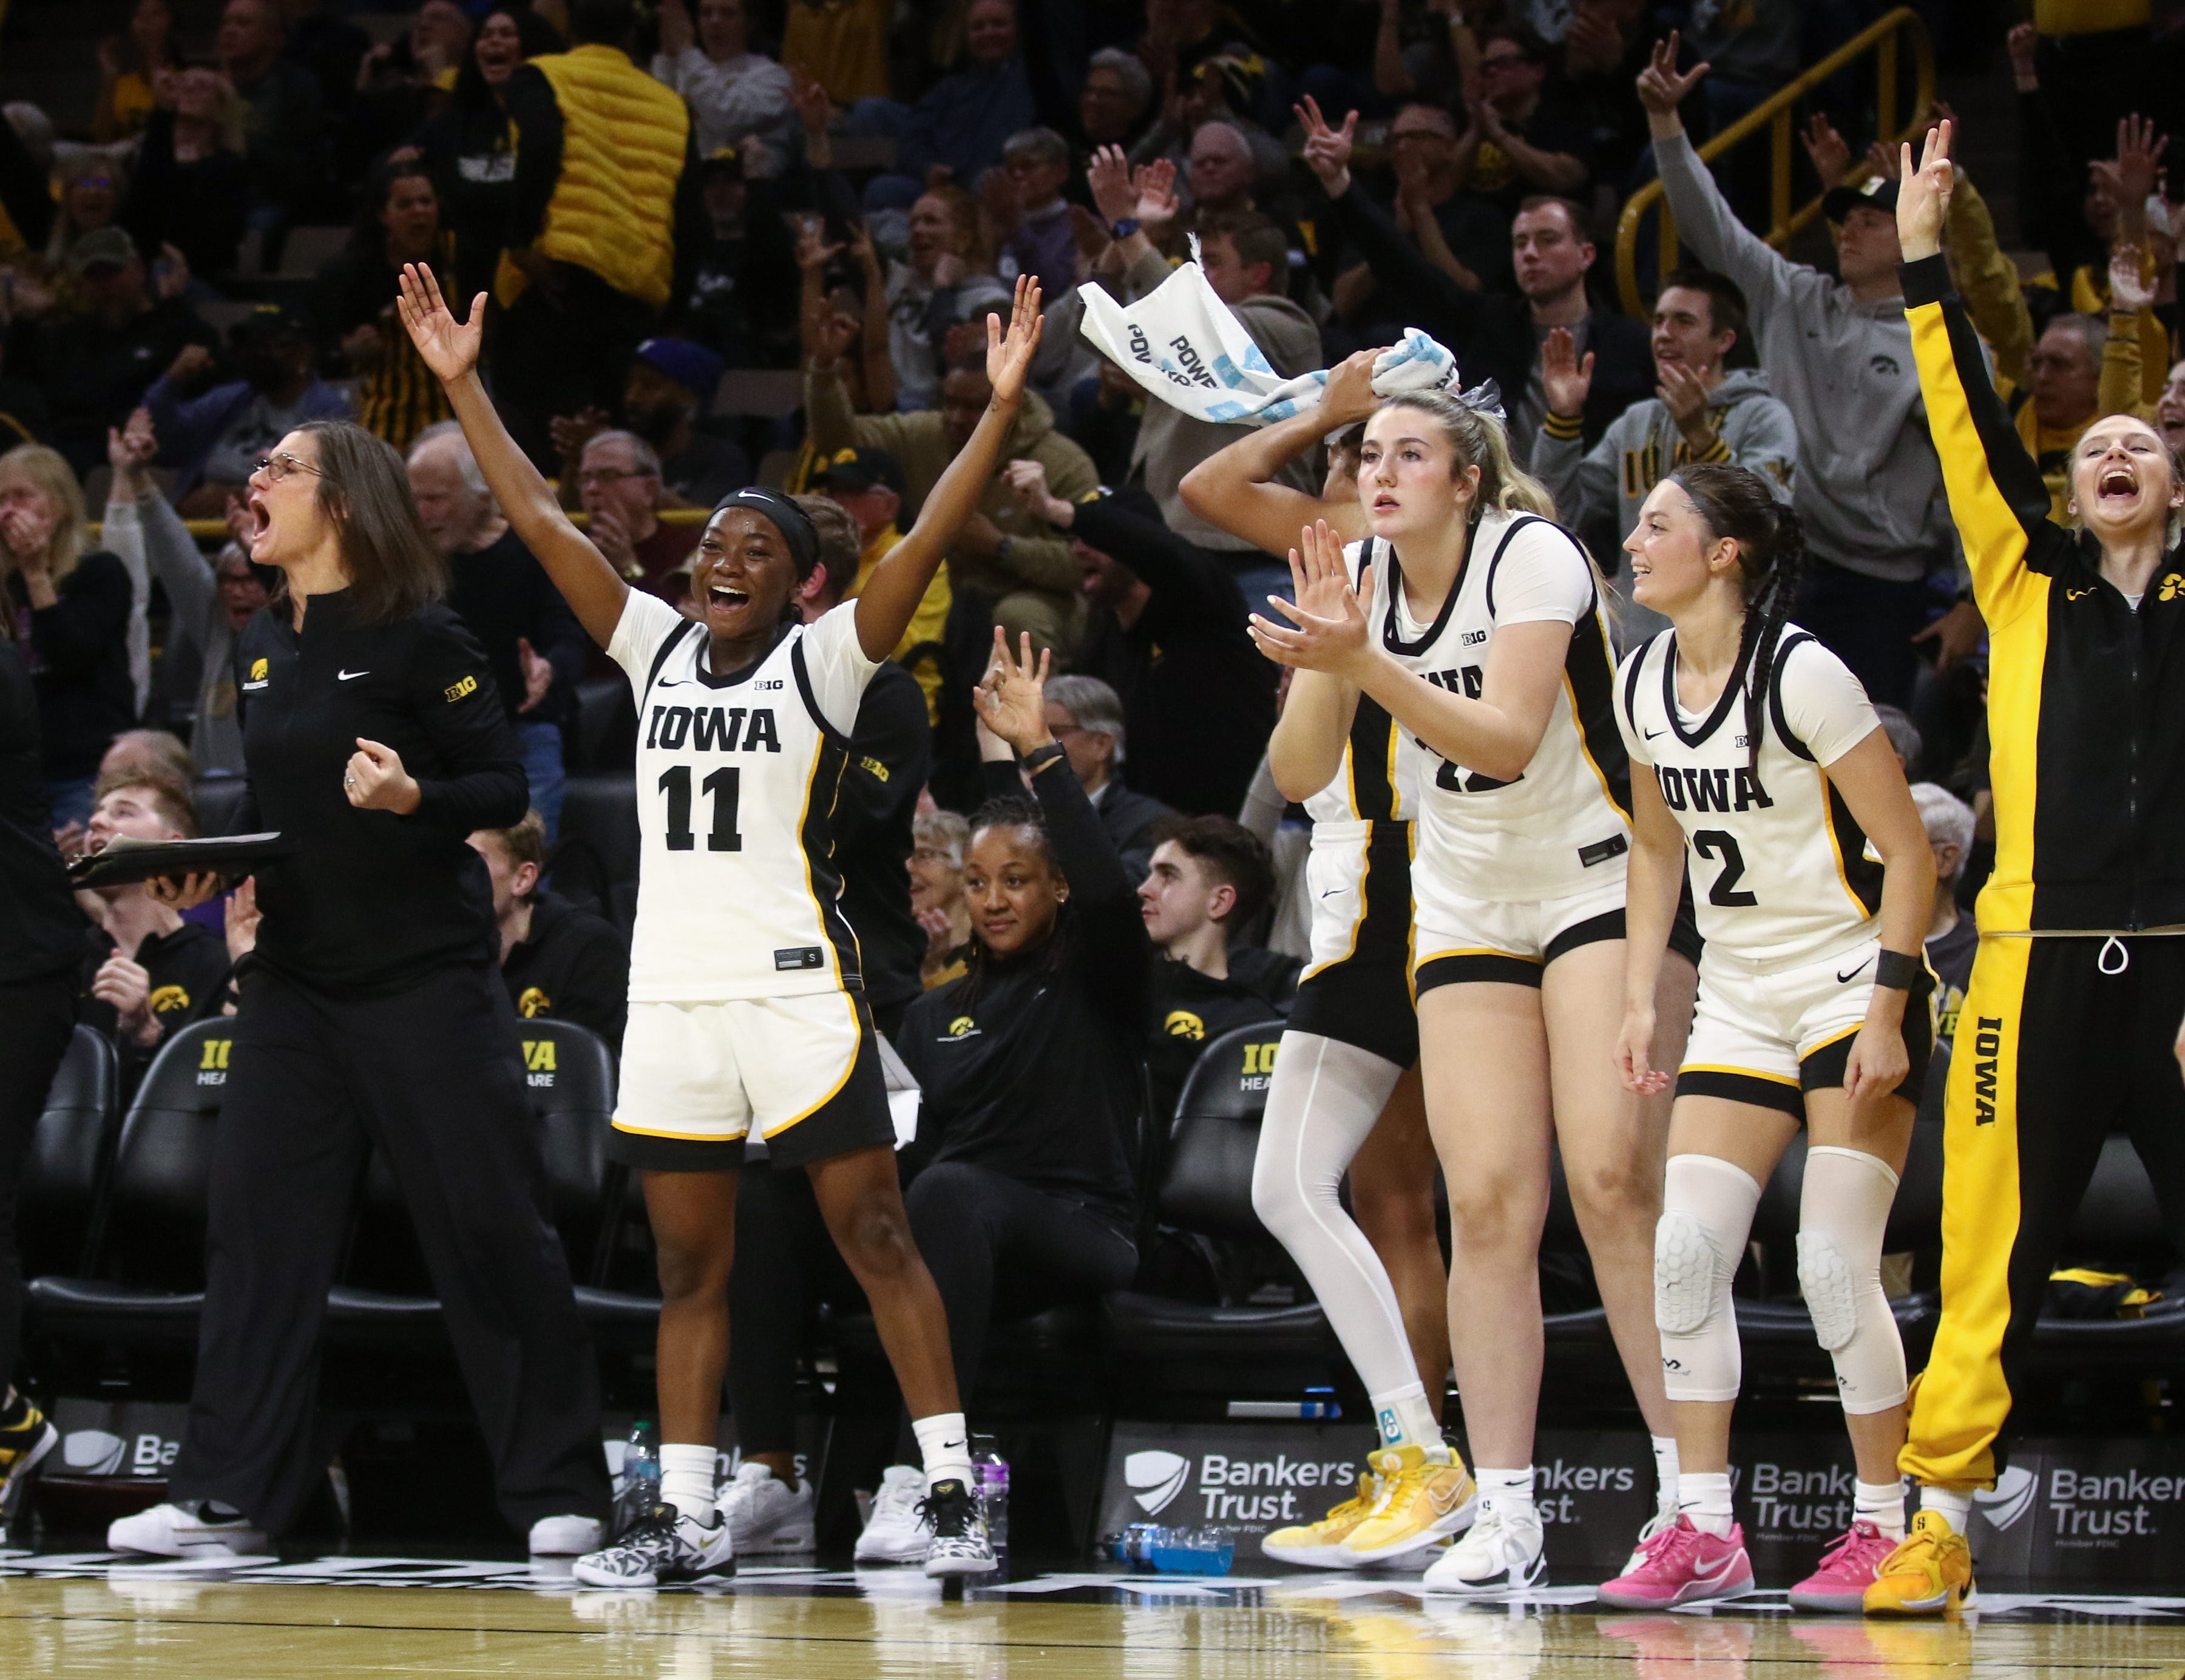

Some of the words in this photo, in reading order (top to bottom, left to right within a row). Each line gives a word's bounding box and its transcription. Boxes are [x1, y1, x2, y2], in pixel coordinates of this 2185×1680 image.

[647, 705, 781, 753] IOWA
[659, 765, 742, 852] 11
[1693, 830, 1758, 907] 2
[808, 953, 816, 962] S
[1975, 1016, 2002, 1126] IOWA
[1201, 1454, 1355, 1486] Bankers
[1752, 1496, 1851, 1529] Trust
